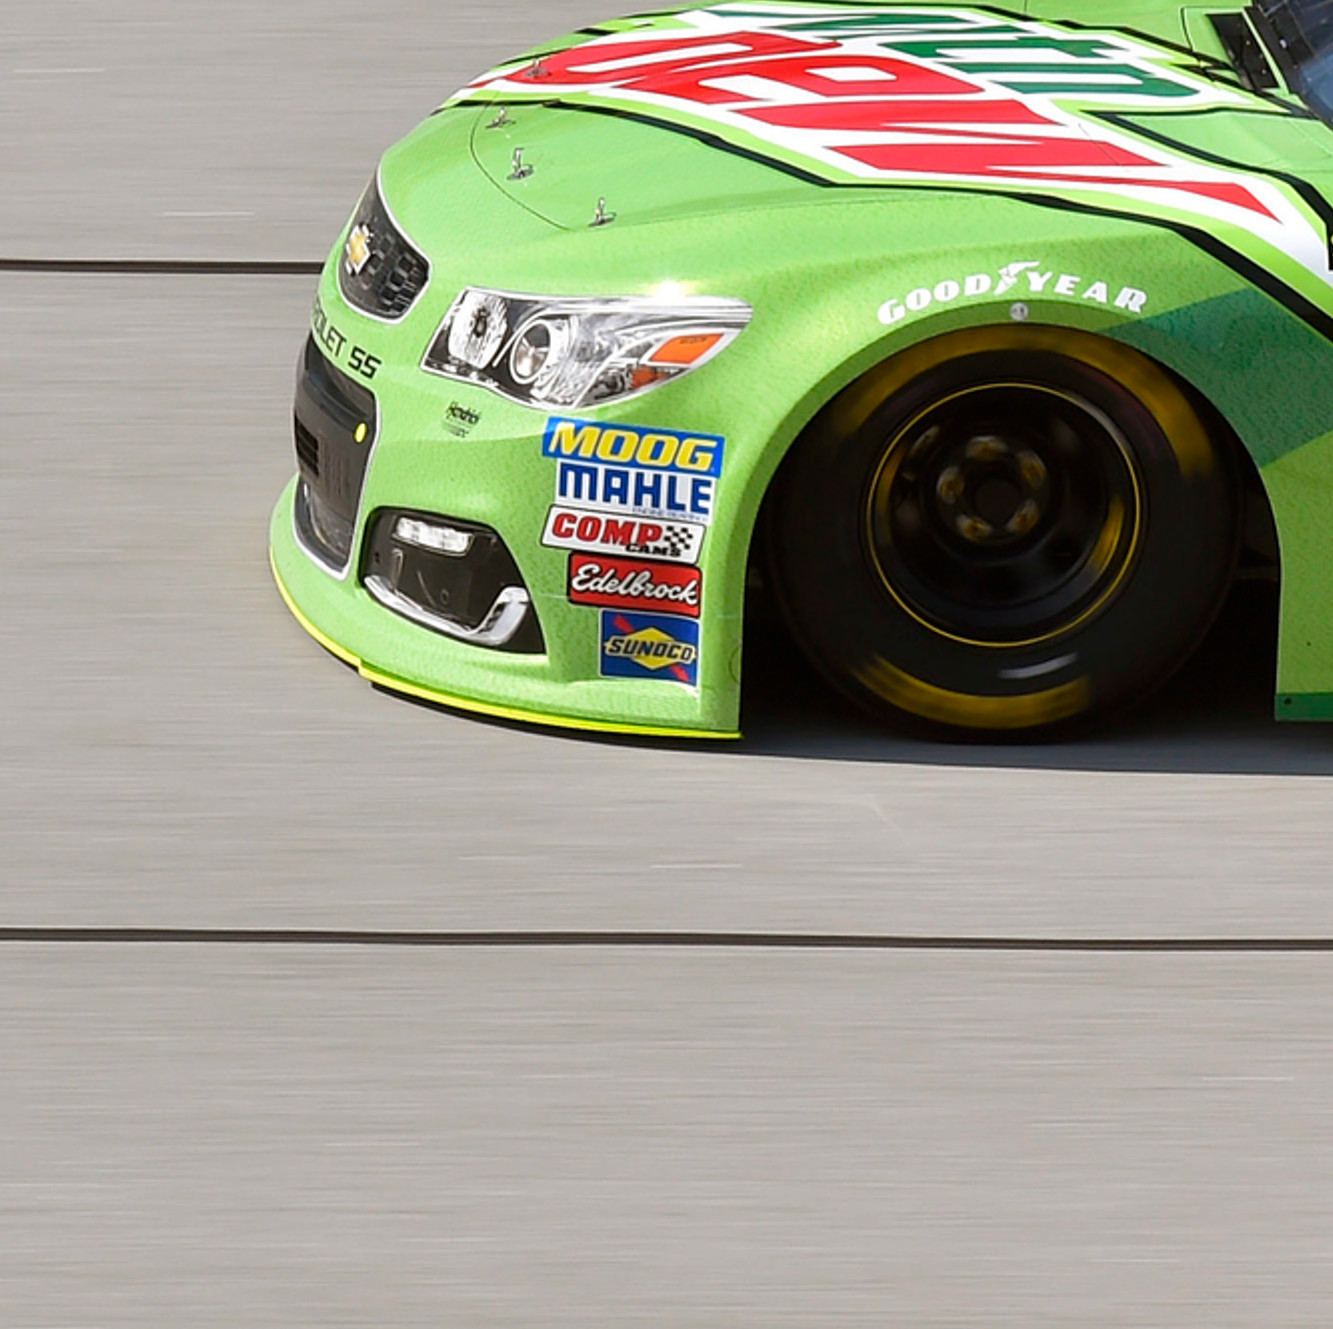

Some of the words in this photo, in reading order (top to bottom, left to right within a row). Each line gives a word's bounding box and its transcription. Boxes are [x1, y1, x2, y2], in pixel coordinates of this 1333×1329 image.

[877, 270, 1148, 325] GOODYEAR
[347, 345, 382, 379] SS
[549, 421, 717, 471] MOOG
[559, 461, 712, 515] MAHLE
[552, 513, 663, 547] COMP
[625, 543, 682, 558] CAMS
[571, 563, 699, 605] Edelbrock
[607, 638, 693, 661] SUNOCO
